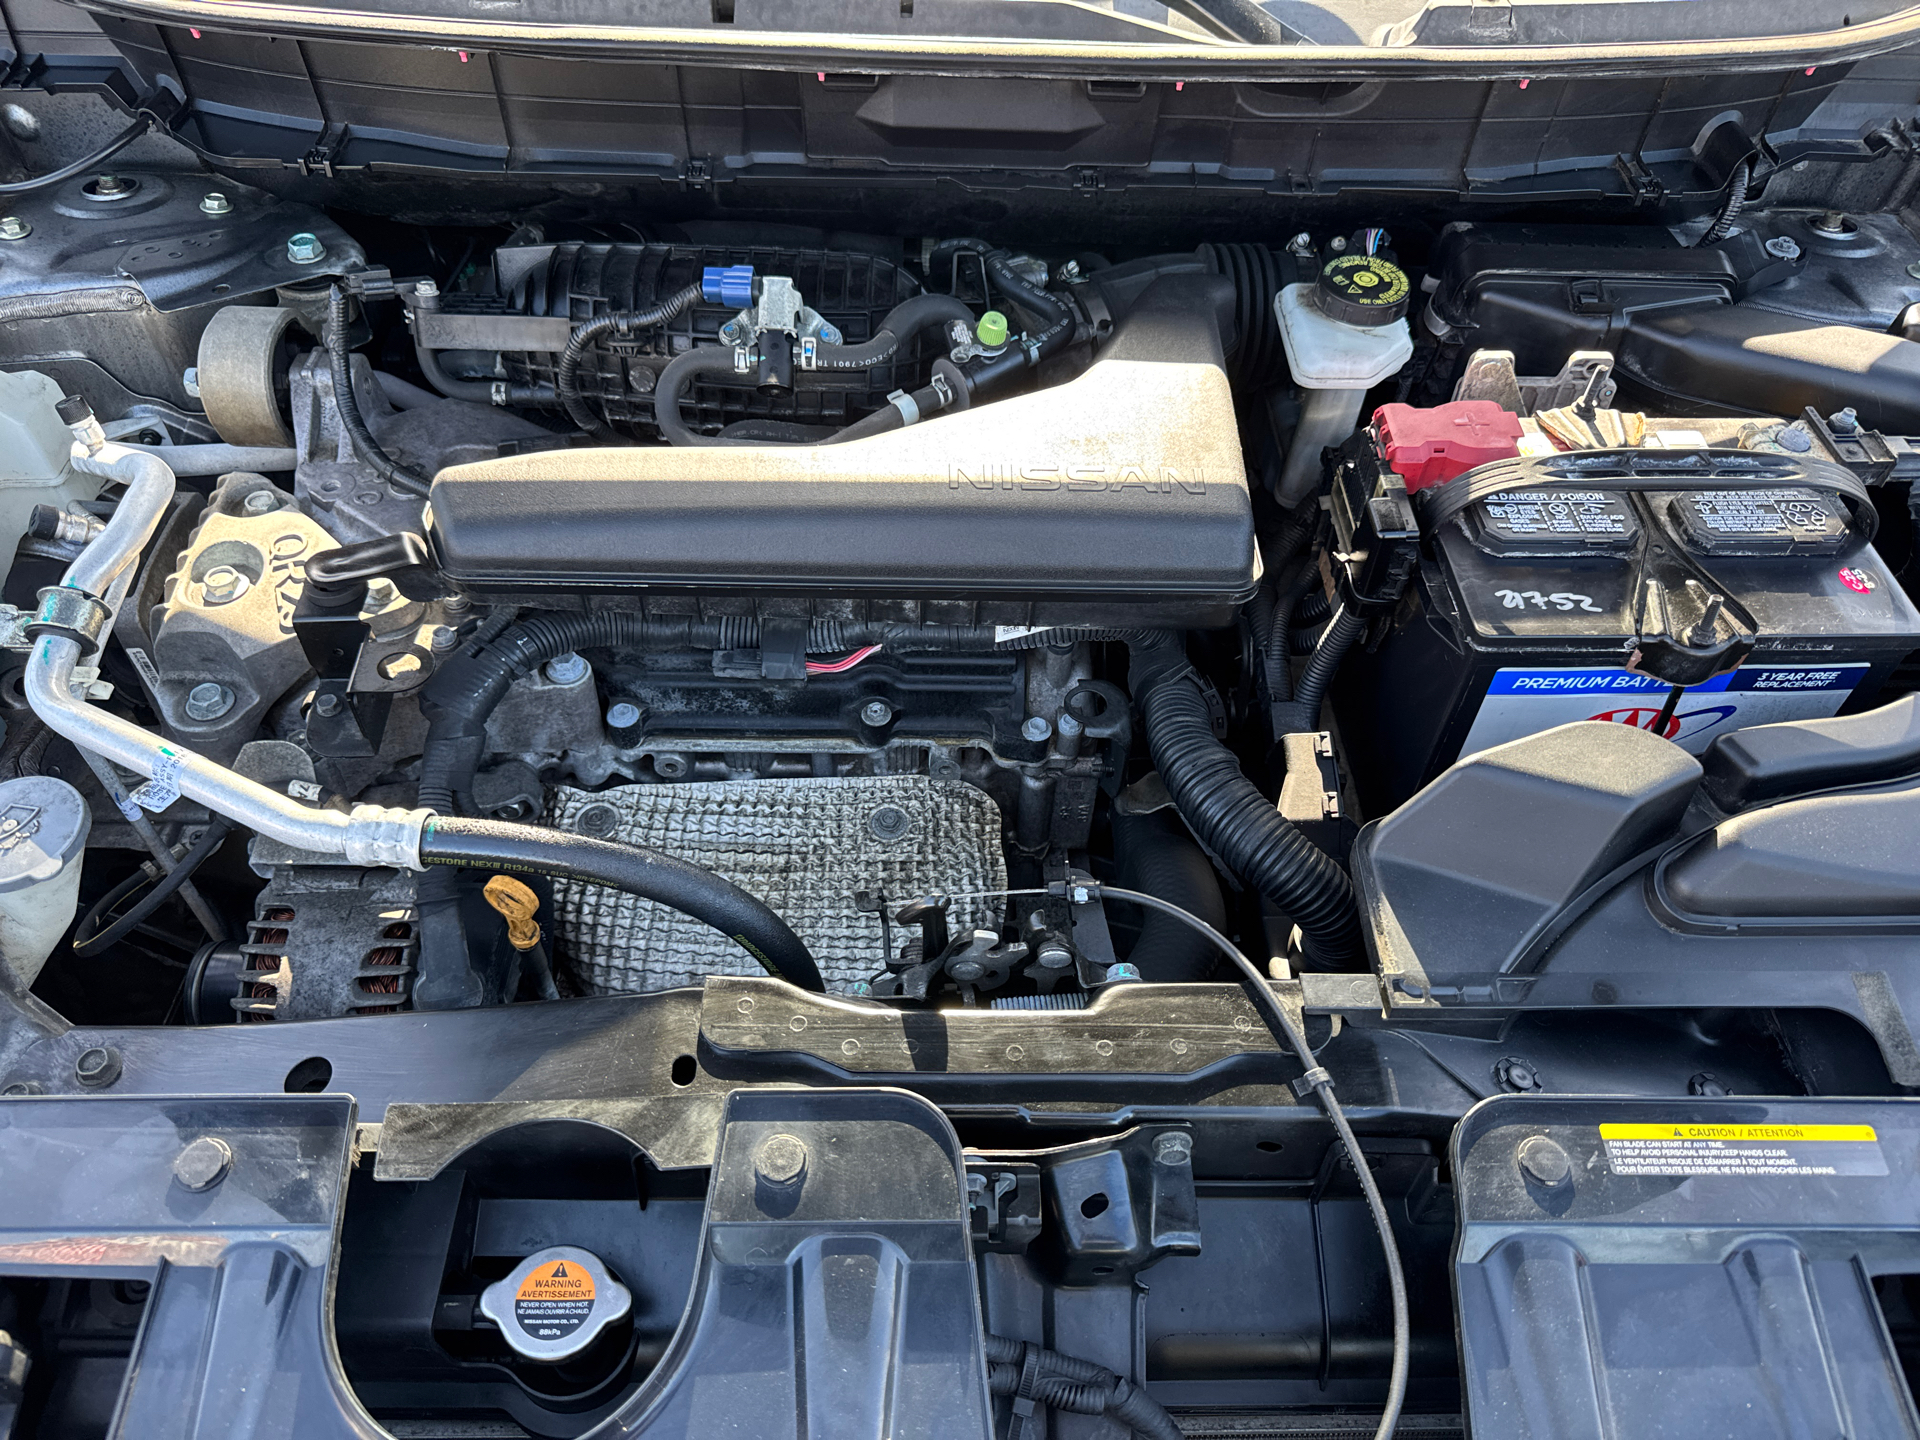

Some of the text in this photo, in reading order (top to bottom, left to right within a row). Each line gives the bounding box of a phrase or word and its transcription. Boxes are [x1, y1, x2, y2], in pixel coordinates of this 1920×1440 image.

[948, 463, 1206, 496] NISSAN
[1499, 493, 1548, 501] DANGER
[1560, 492, 1605, 500] POISON
[1840, 569, 1863, 591] C-25
[1804, 671, 1842, 680] FREE
[1511, 676, 1612, 689] PREMIUM
[1688, 1127, 1736, 1137] CAUTION
[1747, 1128, 1804, 1138] ATTENTION
[1609, 1141, 1725, 1149] FAN BLADE CAN START AT ANY TIME.
[1611, 1149, 1621, 1157] TO
[1622, 1149, 1639, 1157] HELP
[1641, 1149, 1661, 1157] AVOID
[1661, 1149, 1698, 1157] PERSONAL
[1703, 1156, 1741, 1165] DÉMARRER
[535, 1279, 582, 1289] WARNING
[521, 1290, 592, 1298] AVERTISSEMENT
[538, 1328, 561, 1336] 88kPa
